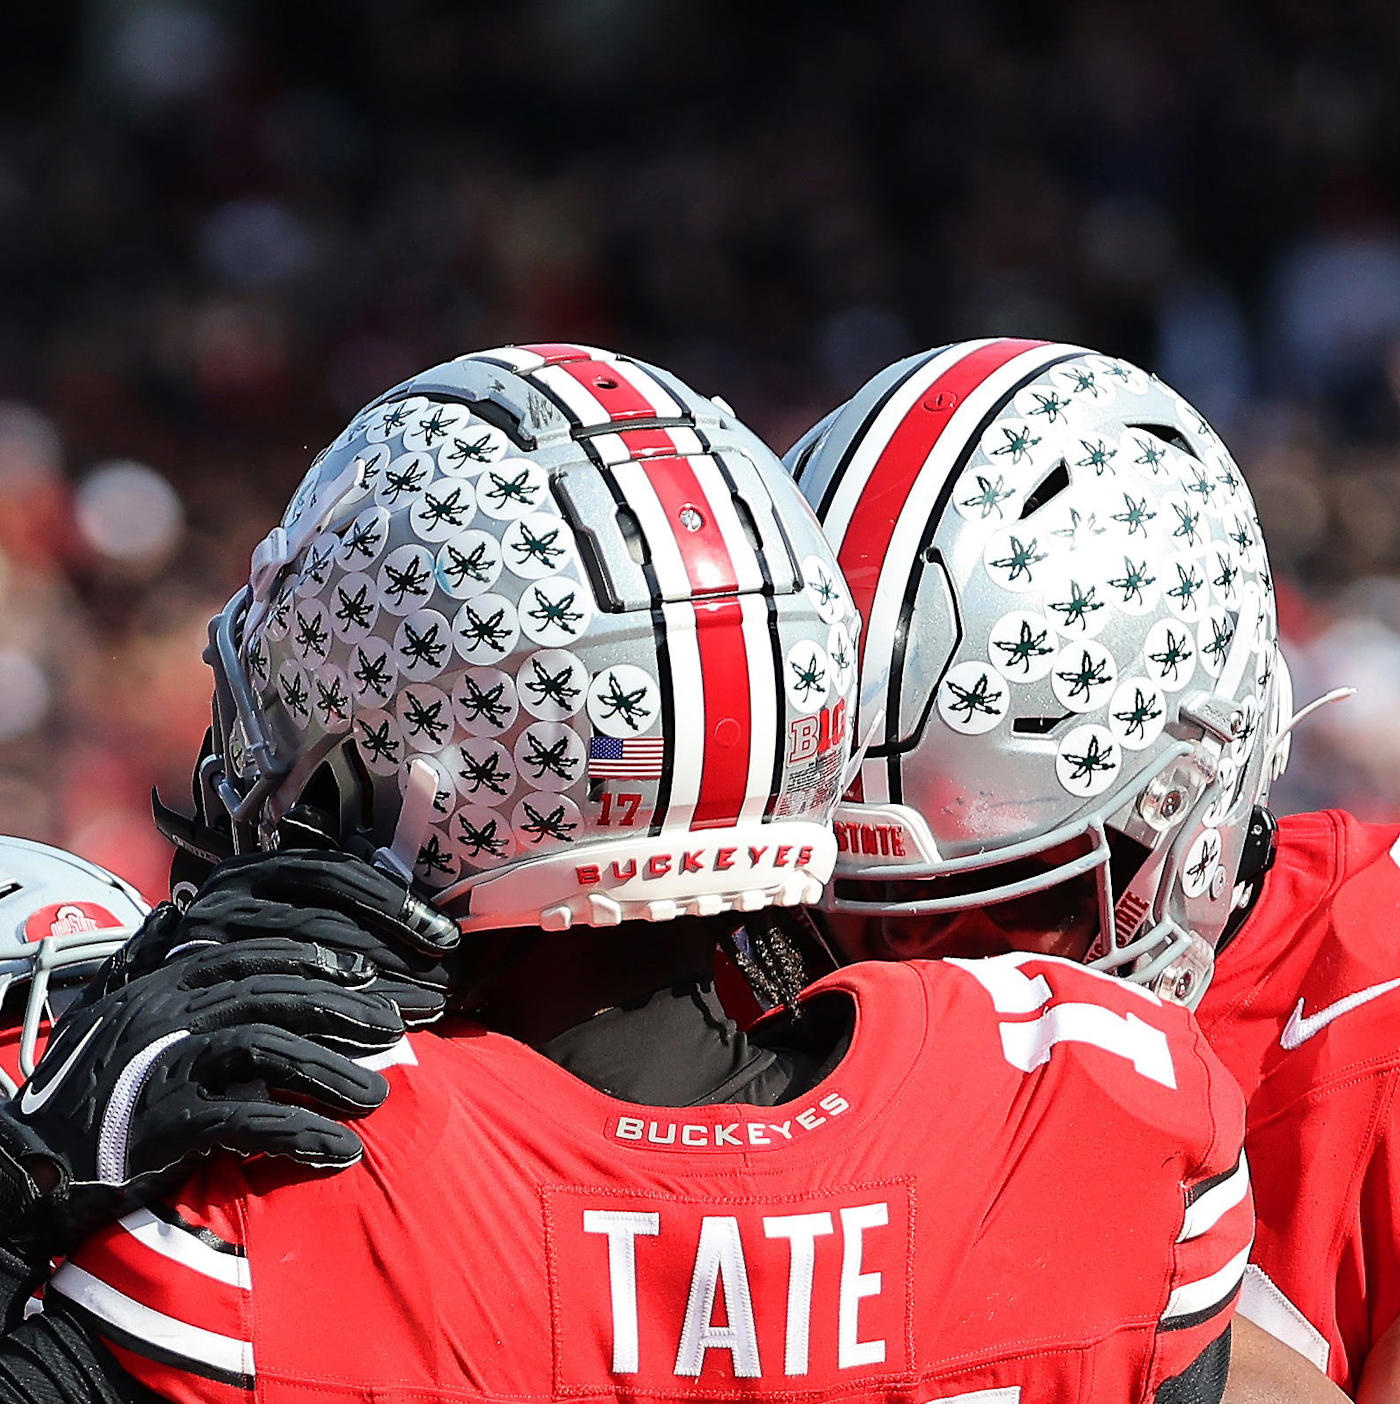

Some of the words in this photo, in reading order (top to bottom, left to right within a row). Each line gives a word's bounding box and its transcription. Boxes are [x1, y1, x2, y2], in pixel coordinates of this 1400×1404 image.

[596, 793, 642, 827] 17
[834, 821, 906, 857] STATE
[576, 845, 814, 886] BUCKEYES
[615, 1092, 850, 1146] BUCKEYES
[583, 1202, 889, 1379] TATE
